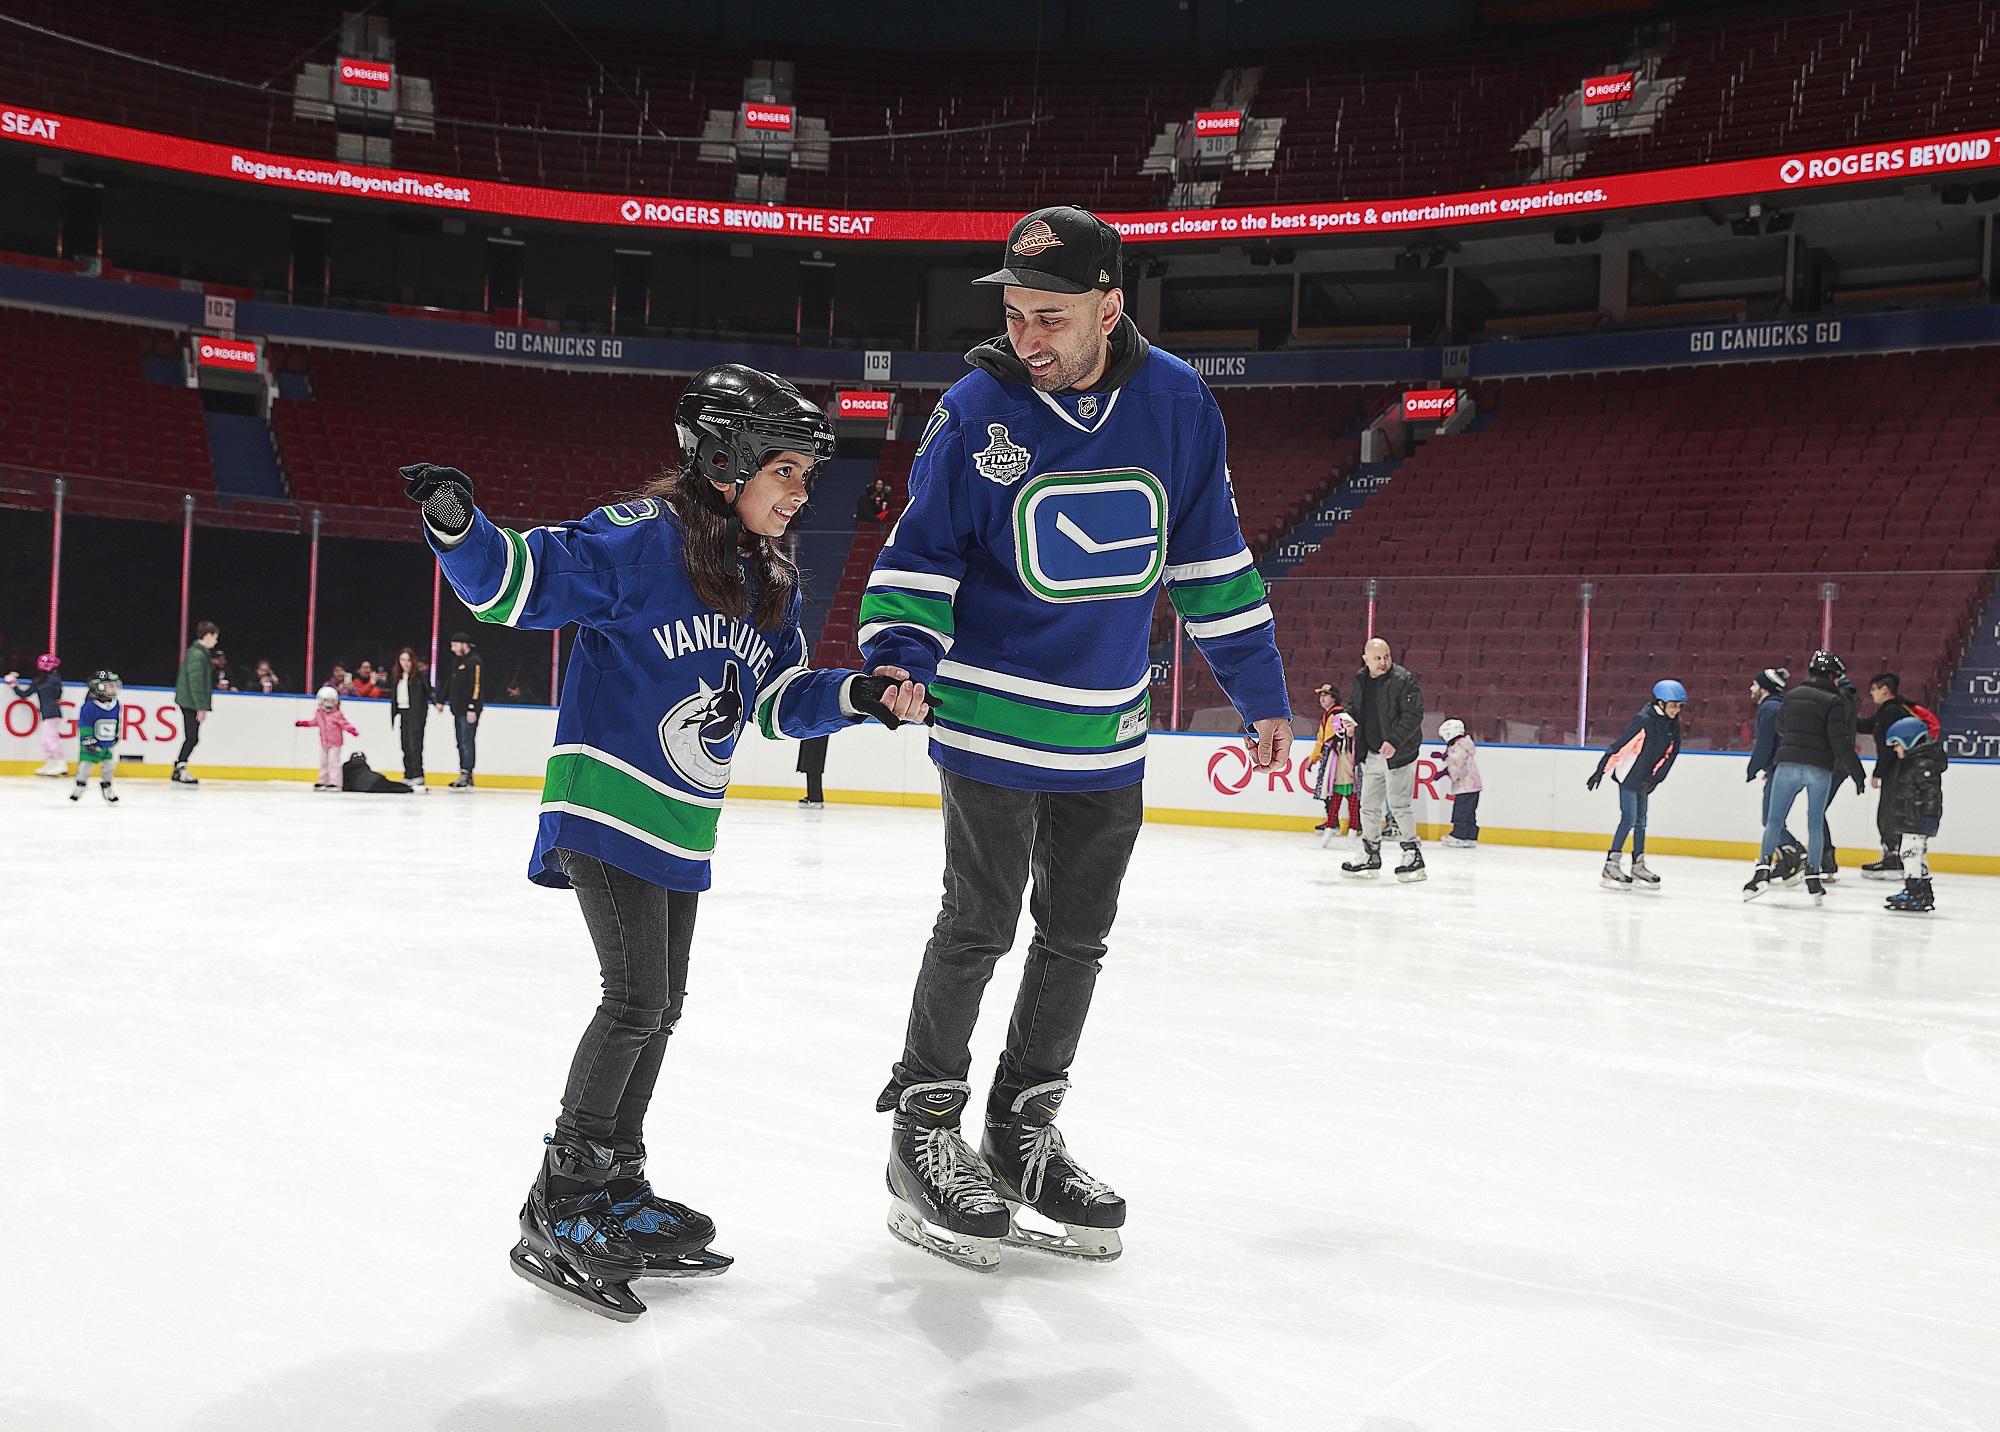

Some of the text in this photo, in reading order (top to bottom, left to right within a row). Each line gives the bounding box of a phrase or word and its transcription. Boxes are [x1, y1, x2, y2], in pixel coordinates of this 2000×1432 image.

[353, 67, 390, 82] ROGERS
[757, 111, 790, 123] ROGERS
[1207, 117, 1240, 129] ROGERS
[1, 111, 61, 140] SEAT
[1809, 149, 1904, 179] ROGERS
[1909, 139, 1991, 168] BEYOND
[231, 154, 471, 203] Rogers.com/BeyondTheSeat
[644, 203, 875, 234] ROGERS BEYOND THE SEAT
[1171, 216, 1218, 233] closer
[1220, 215, 1238, 231] to
[1240, 213, 1267, 230] the
[1271, 212, 1307, 229] best
[1309, 210, 1361, 231] sports
[1363, 207, 1378, 224] &
[1381, 199, 1497, 224] entertainment
[1500, 188, 1608, 215] experiences.
[208, 300, 234, 318] 102
[494, 330, 623, 358] GO CANUCKS GO
[1690, 320, 1842, 352] GO CANUCKS GO
[213, 347, 256, 363] ROGERS
[867, 355, 889, 369] 103
[852, 399, 888, 410] ROGERS
[698, 413, 732, 426] BAUER
[812, 430, 836, 442] BAUER
[981, 451, 1027, 467] FINAL
